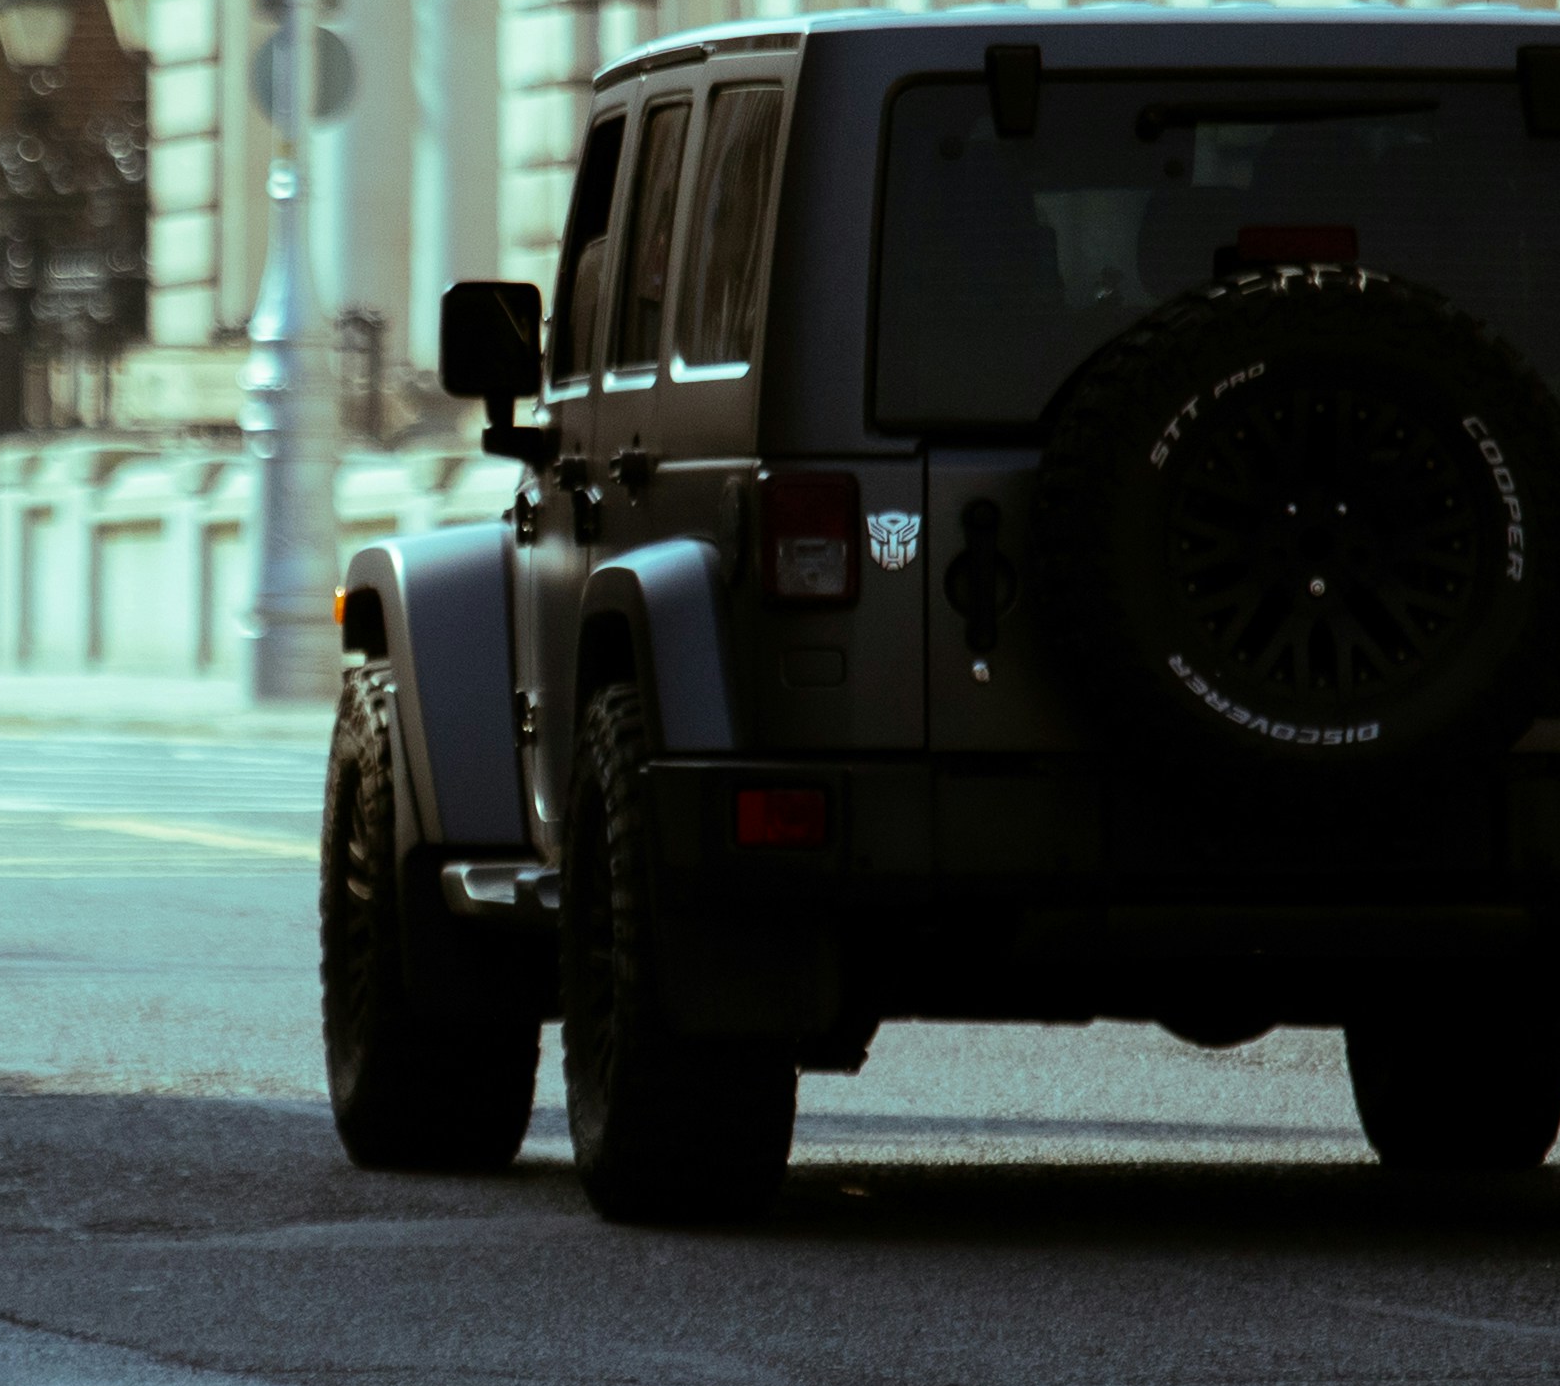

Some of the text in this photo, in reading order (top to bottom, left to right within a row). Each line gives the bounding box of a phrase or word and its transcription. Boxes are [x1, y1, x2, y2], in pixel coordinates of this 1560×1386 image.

[1150, 362, 1265, 471] STT PRO
[1462, 417, 1524, 582] COOPER
[1168, 654, 1380, 746] DISCOVERER
